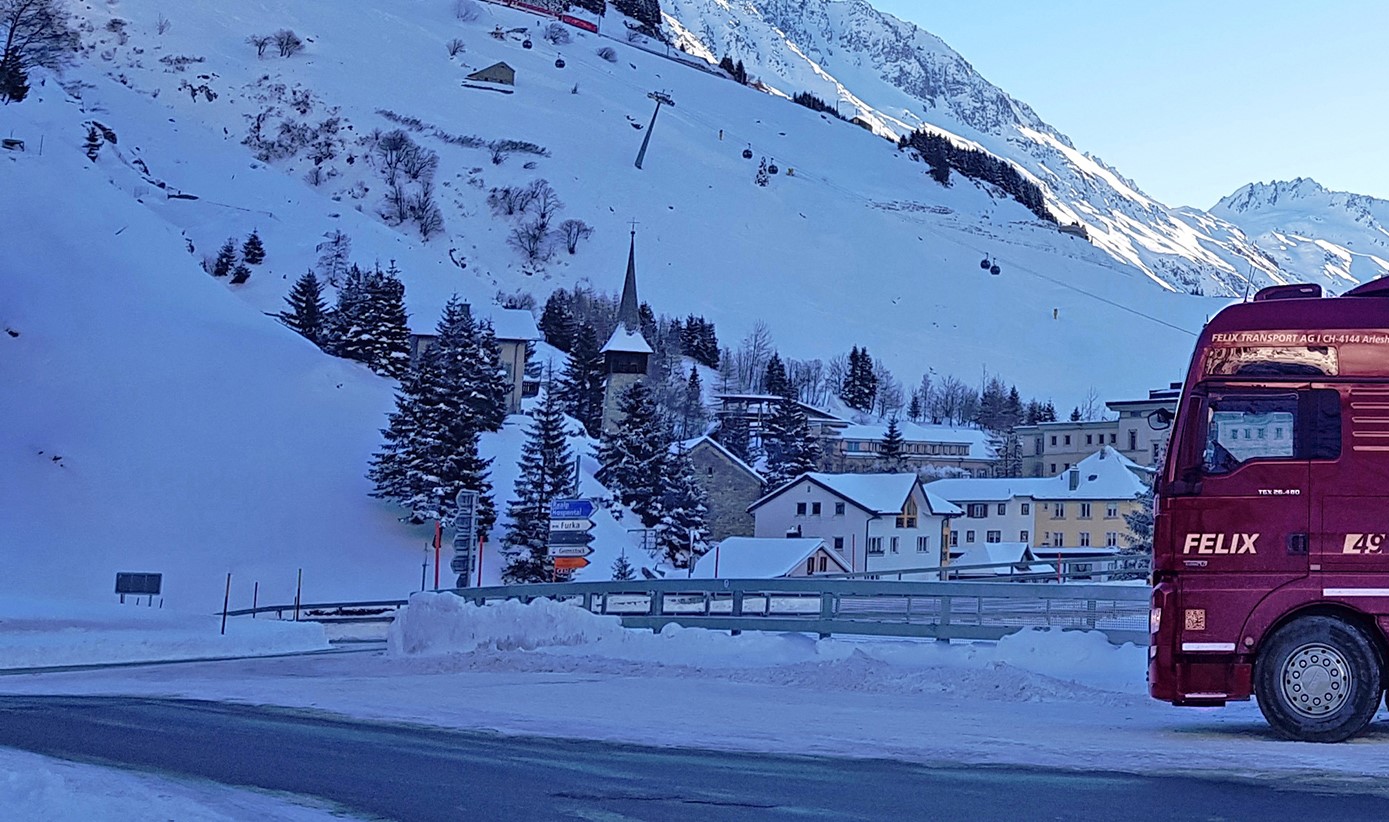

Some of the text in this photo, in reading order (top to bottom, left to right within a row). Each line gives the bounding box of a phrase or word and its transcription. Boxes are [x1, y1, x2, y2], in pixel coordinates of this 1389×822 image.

[1211, 333, 1239, 343] FELIX
[1240, 333, 1299, 343] TRANSPORT
[1300, 334, 1316, 343] AG
[1322, 334, 1361, 344] CH-4144
[560, 521, 580, 529] Furka
[1183, 533, 1260, 554] FELIX
[1349, 533, 1385, 554] 49
